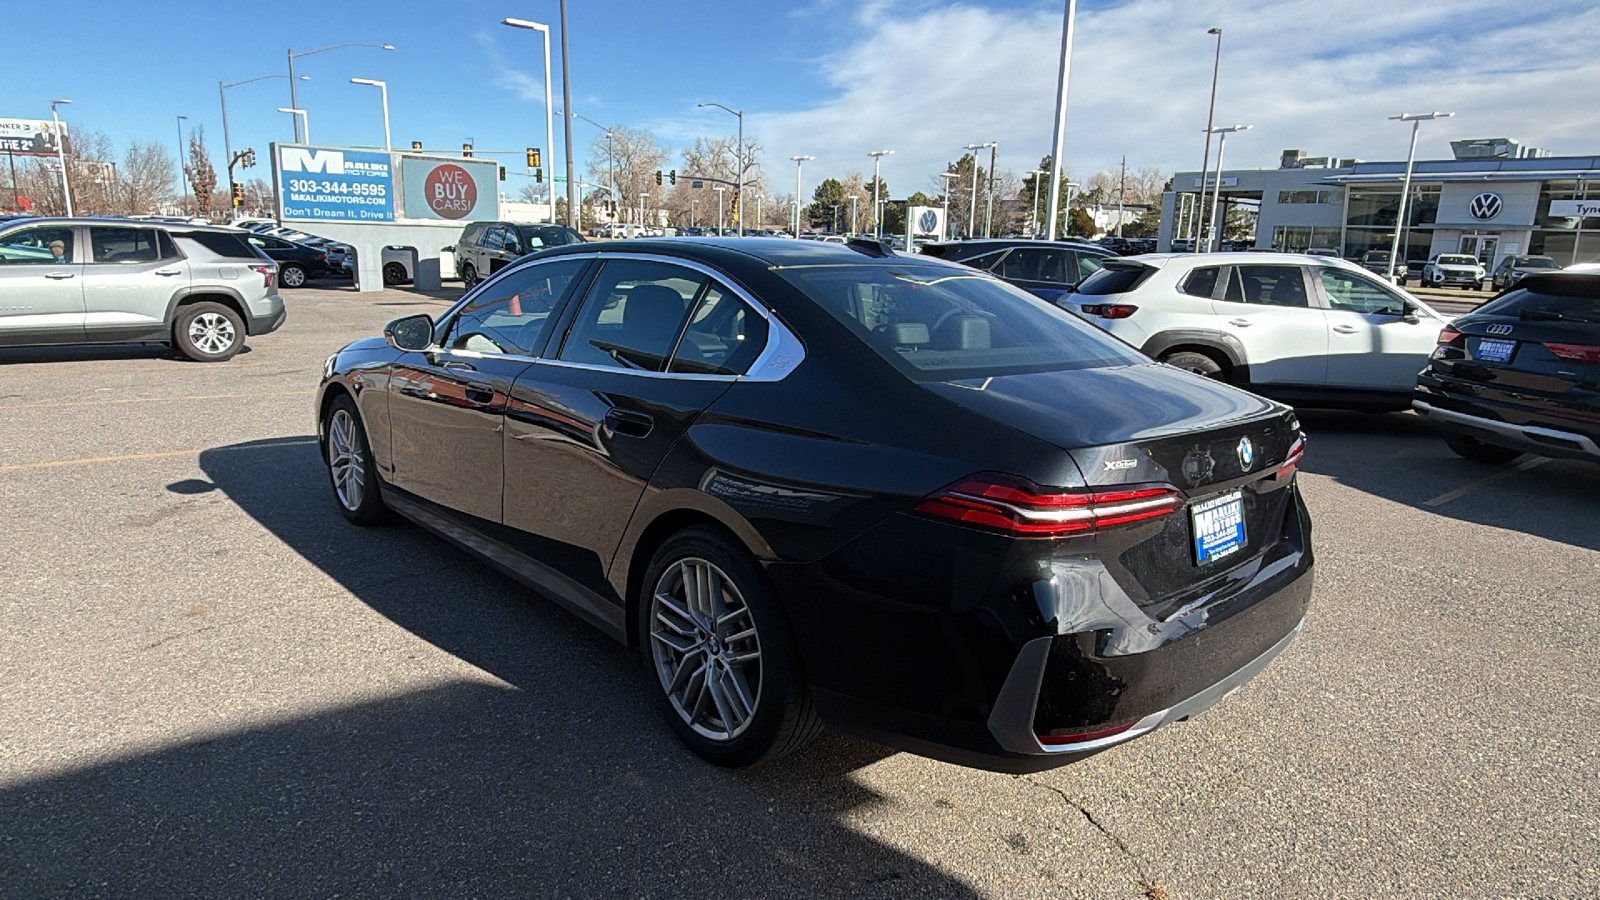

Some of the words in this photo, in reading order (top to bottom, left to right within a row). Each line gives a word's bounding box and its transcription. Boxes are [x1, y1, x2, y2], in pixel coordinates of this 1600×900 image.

[439, 170, 463, 184] WE
[290, 179, 386, 196] 303-344-9595
[434, 183, 468, 199] BUY
[291, 193, 386, 205] MAALIKIMOTORS.COM
[432, 198, 471, 211] CARS!
[284, 207, 310, 216] Don't
[313, 208, 345, 217] Dream
[348, 209, 357, 219] It,
[360, 210, 384, 219] Drive
